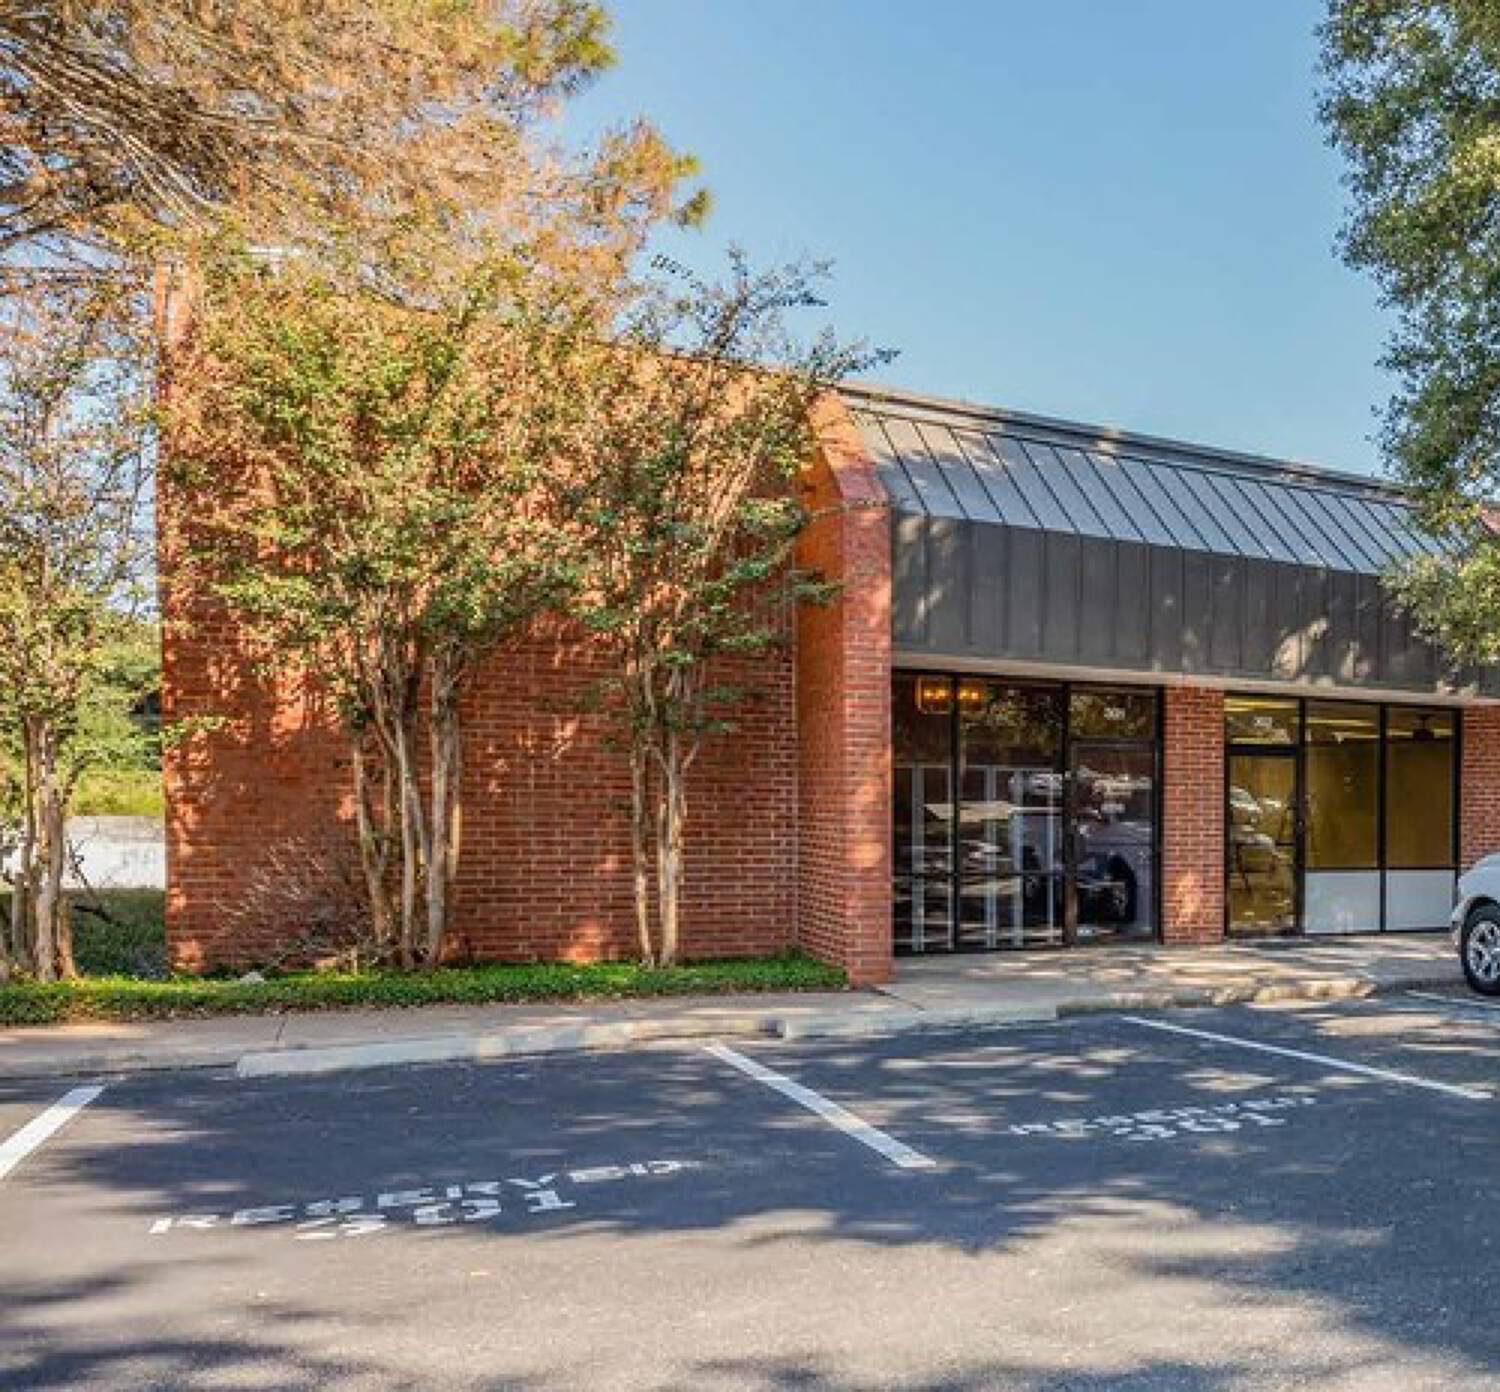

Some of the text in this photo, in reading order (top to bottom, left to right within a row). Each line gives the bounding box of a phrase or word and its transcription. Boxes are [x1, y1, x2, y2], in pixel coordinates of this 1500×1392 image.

[1009, 1097, 1317, 1136] RESERVED
[1113, 1112, 1286, 1141] 301
[148, 1160, 685, 1233] RESERVED
[293, 1189, 576, 1240] 301
